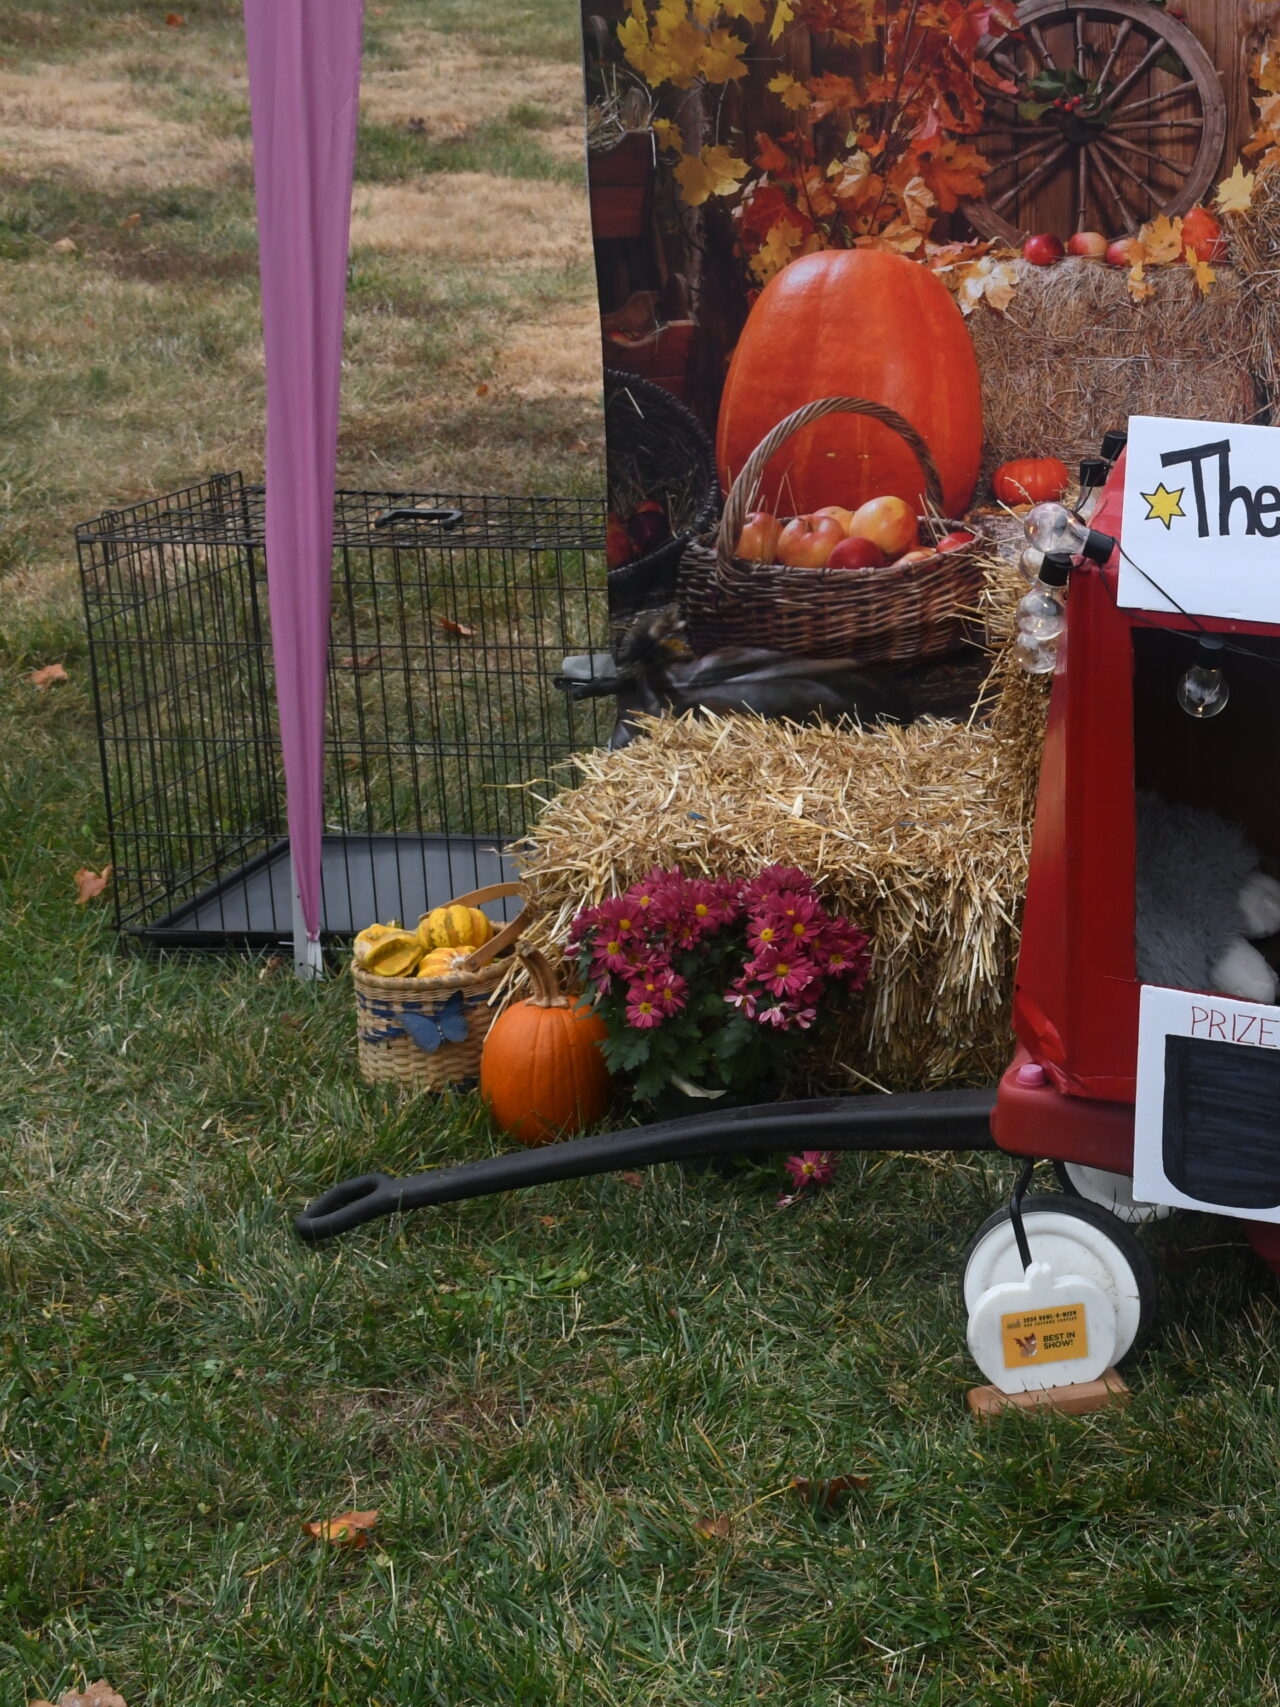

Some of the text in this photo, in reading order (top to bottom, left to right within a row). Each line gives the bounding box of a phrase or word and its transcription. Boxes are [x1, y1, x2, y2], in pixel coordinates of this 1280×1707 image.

[1191, 1005, 1280, 1047] PRIZE
[1043, 1331, 1076, 1343] BEST IN
[1043, 1339, 1074, 1350] SHOW!
